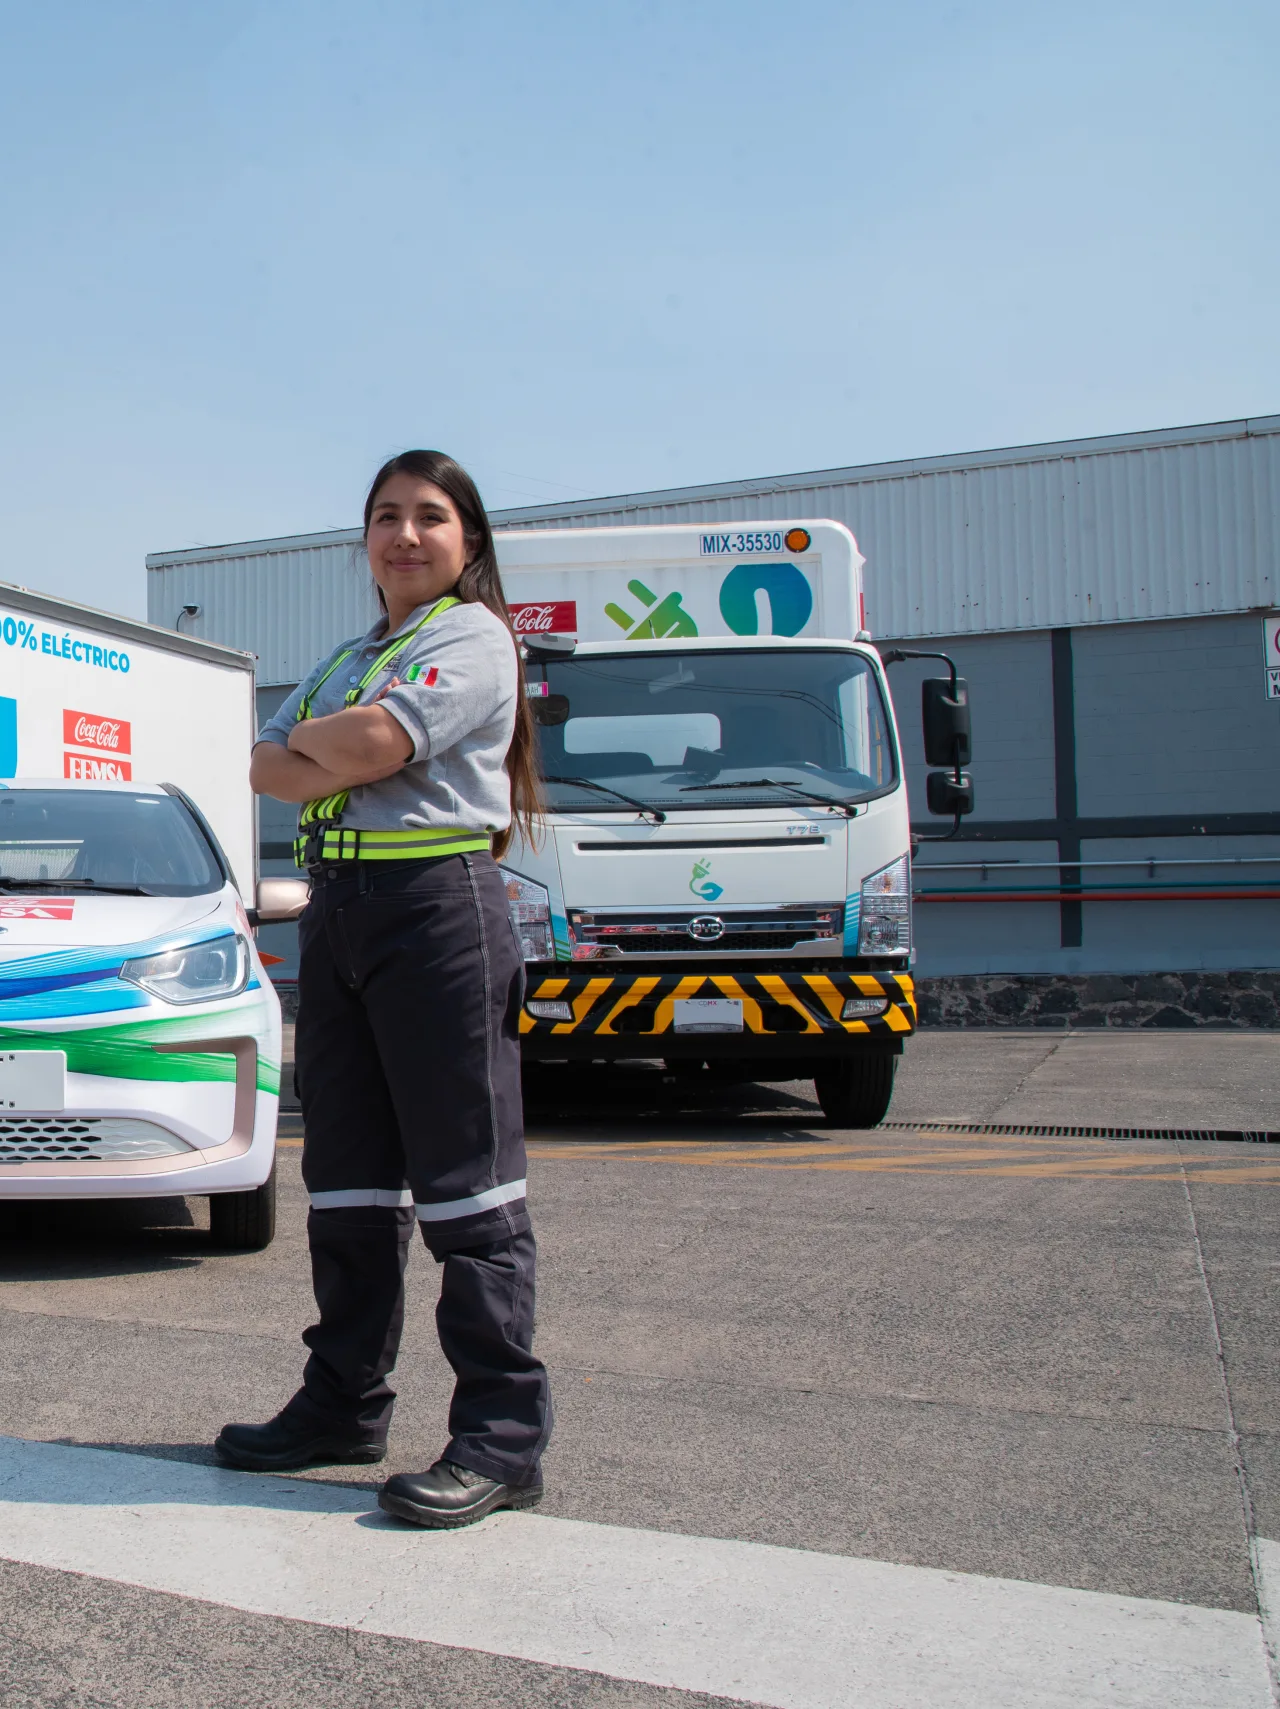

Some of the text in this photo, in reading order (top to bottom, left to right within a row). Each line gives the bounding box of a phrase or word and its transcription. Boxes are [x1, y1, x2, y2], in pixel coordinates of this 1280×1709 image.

[703, 532, 781, 553] MIX-35530
[41, 633, 130, 673] ELÉCTRICO
[74, 716, 120, 748] Coca-Cola
[68, 756, 124, 781] FEMSA
[693, 924, 720, 933] BYD
